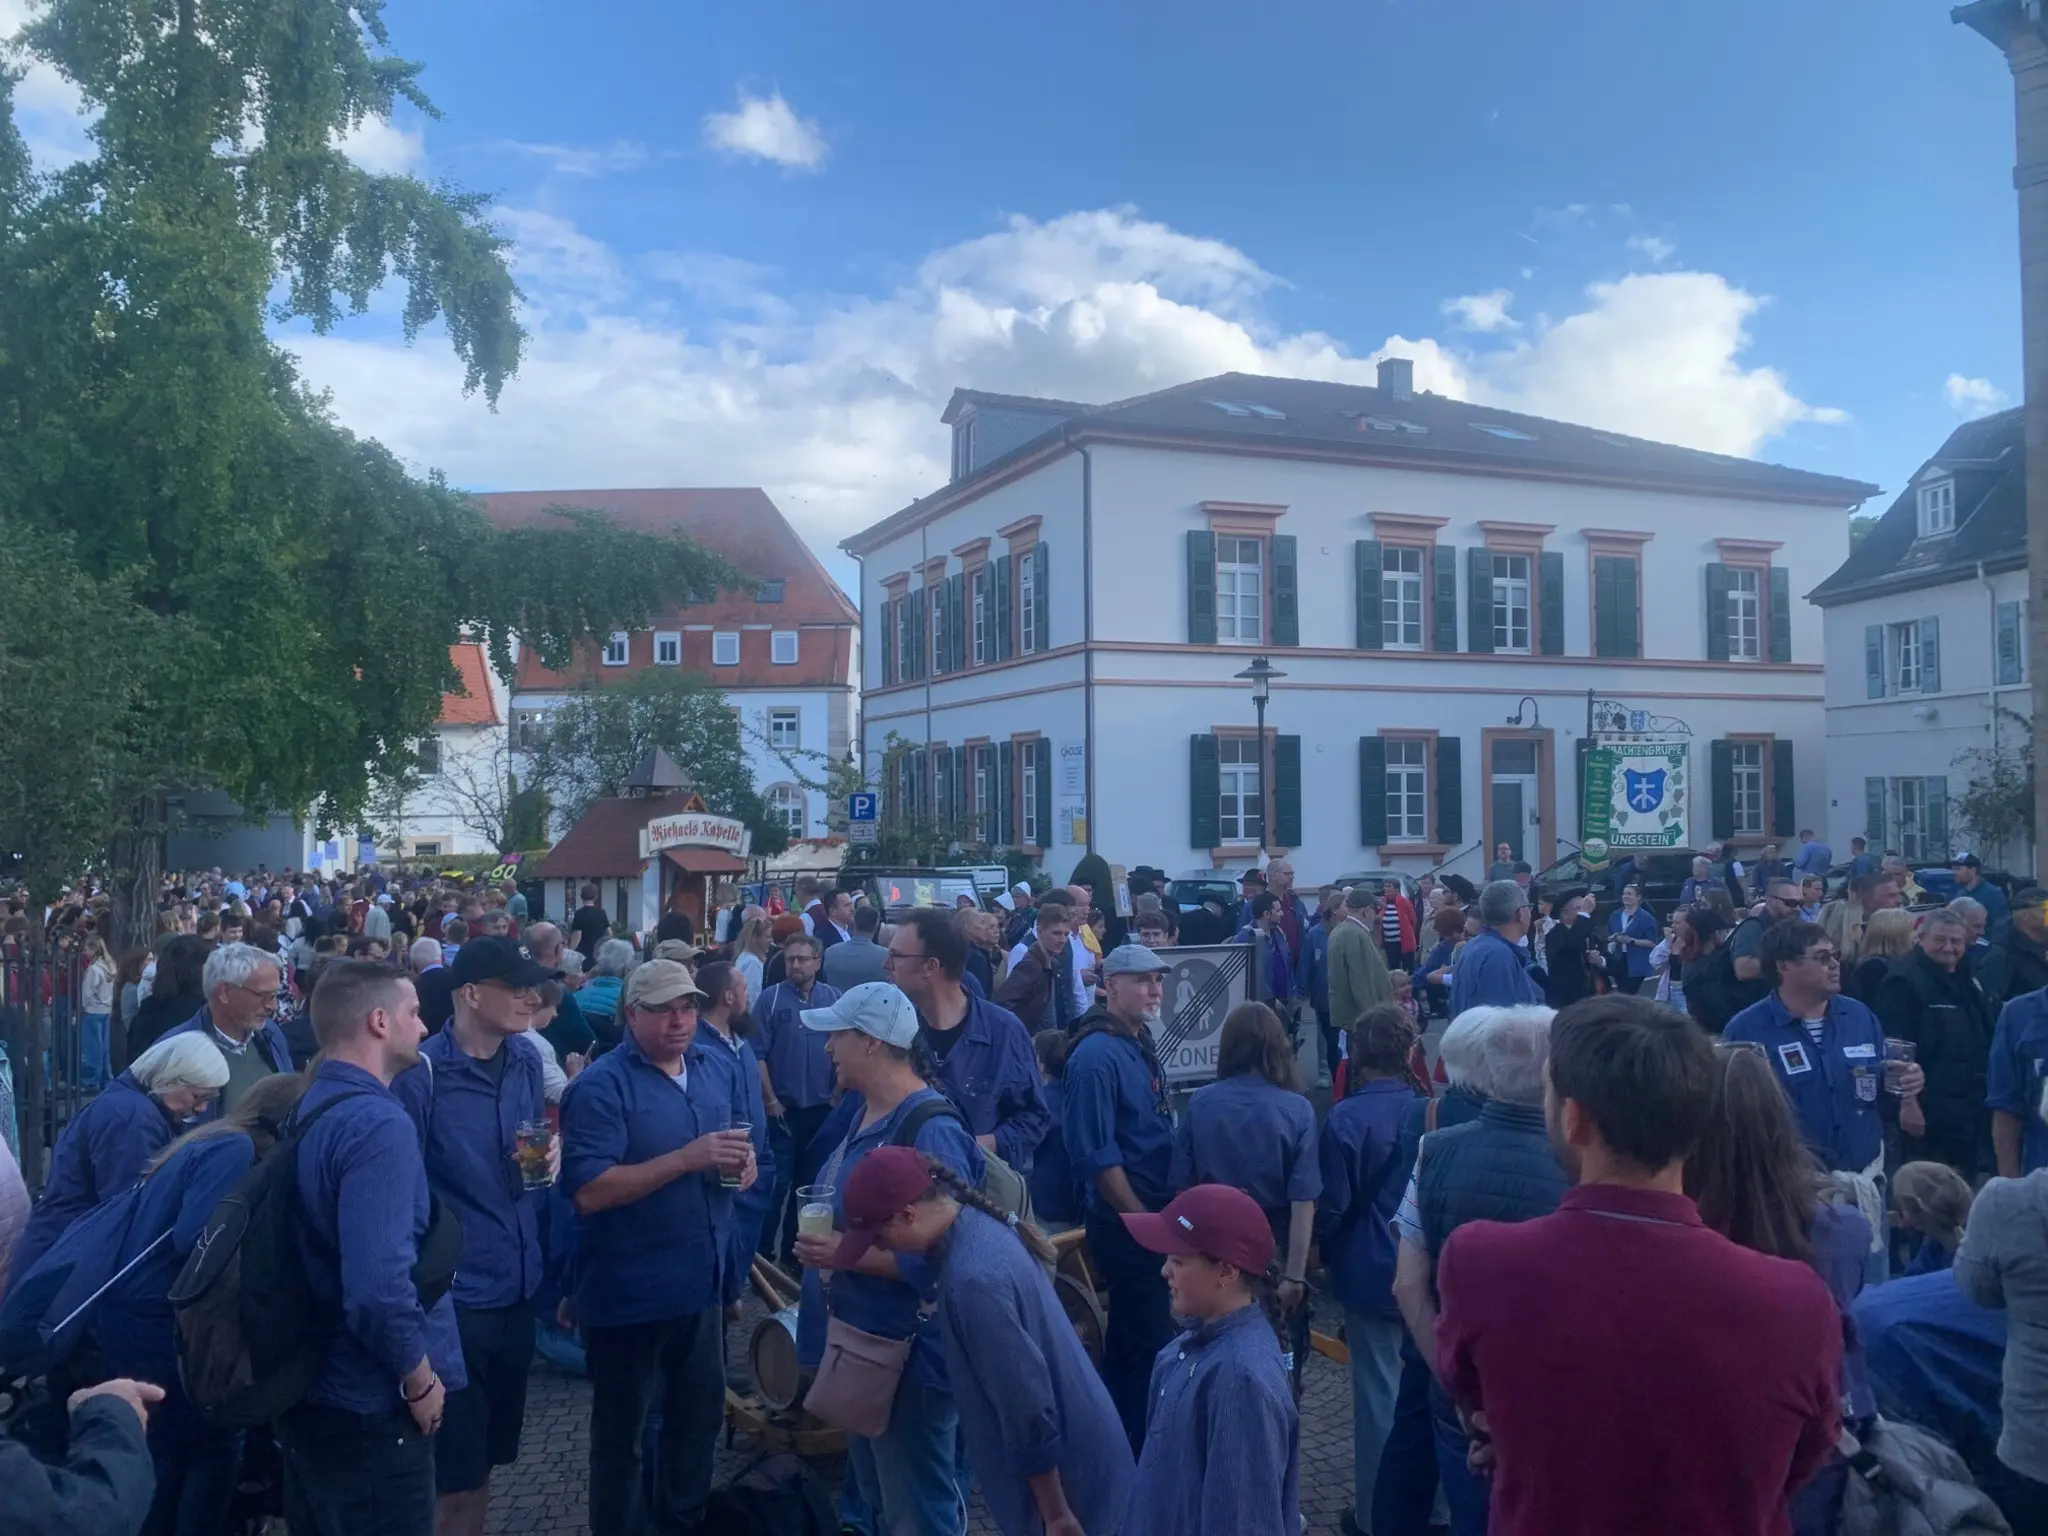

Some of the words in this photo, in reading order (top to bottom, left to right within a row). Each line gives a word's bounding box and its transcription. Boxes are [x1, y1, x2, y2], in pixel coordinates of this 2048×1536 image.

[855, 796, 870, 818] P
[700, 821, 740, 843] Kapelle
[491, 863, 517, 880] 60
[1168, 1045, 1220, 1068] ZONE
